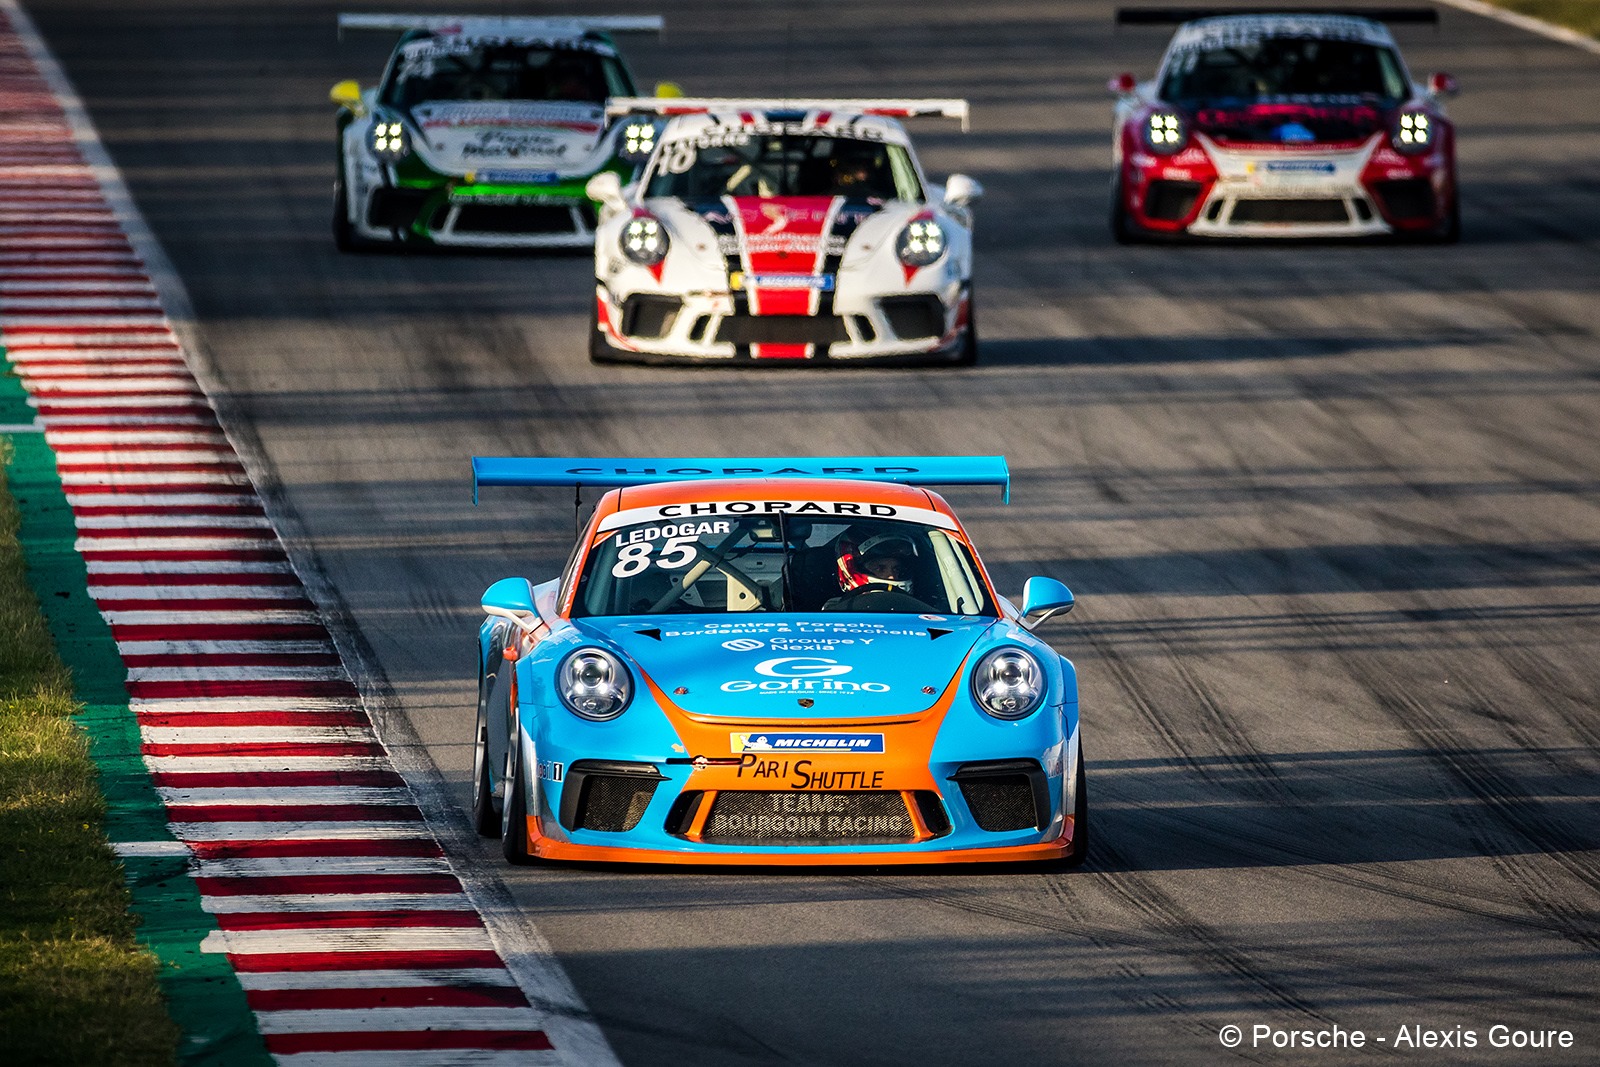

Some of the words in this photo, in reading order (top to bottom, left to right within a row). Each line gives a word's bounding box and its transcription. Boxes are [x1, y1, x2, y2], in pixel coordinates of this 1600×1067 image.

[565, 467, 920, 475] CHOPARD
[658, 501, 897, 518] CHOPARD
[615, 521, 730, 548] LEDOGAR
[611, 535, 700, 578] 85
[665, 629, 770, 637] Bordeaux
[832, 628, 926, 637] Rochelle
[769, 637, 855, 647] Groupe
[720, 678, 891, 693] Gofrino
[774, 738, 872, 748] MICHELIN
[791, 760, 884, 789] SHUTTLE
[714, 814, 821, 832] BOURGOIN
[827, 815, 902, 832] RACING
